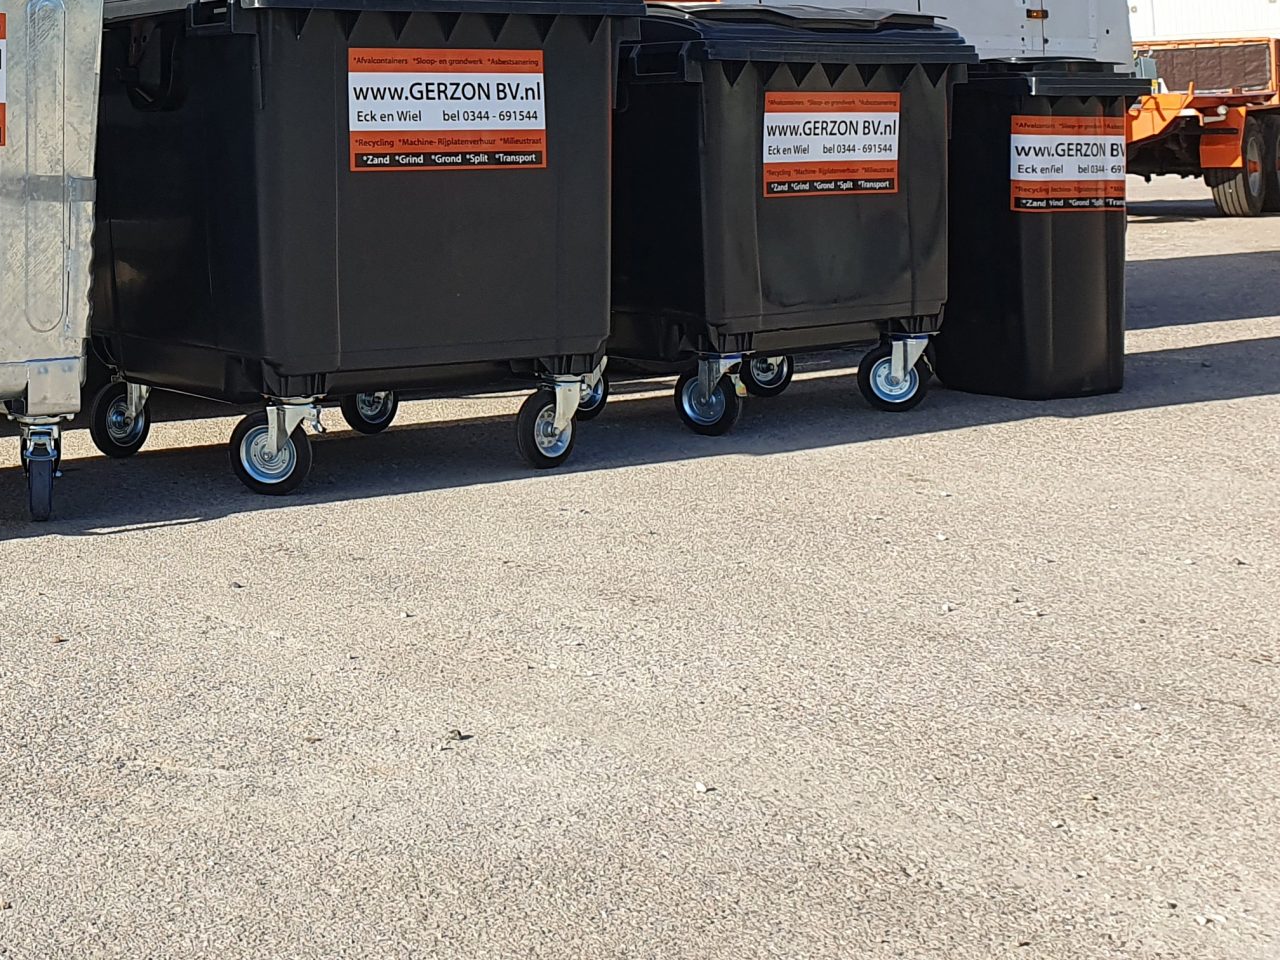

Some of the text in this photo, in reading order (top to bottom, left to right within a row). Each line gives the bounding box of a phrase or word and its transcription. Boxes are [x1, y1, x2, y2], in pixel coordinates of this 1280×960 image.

[353, 82, 541, 101] www.GERZON BV.nl
[357, 110, 377, 122] Eck
[380, 113, 394, 122] en
[396, 110, 422, 122] Wiel
[442, 110, 460, 121] bel
[463, 111, 489, 121] 0344
[499, 110, 538, 121] 691544
[766, 120, 896, 136] www.GERZON BV.nl
[768, 145, 781, 155] Eck
[782, 147, 791, 155] en
[793, 144, 809, 154] Wiel
[823, 144, 835, 154] bel
[836, 144, 856, 153] 0344
[862, 144, 892, 153] 691544
[1017, 164, 1038, 174] Eck
[1078, 164, 1089, 174] bel
